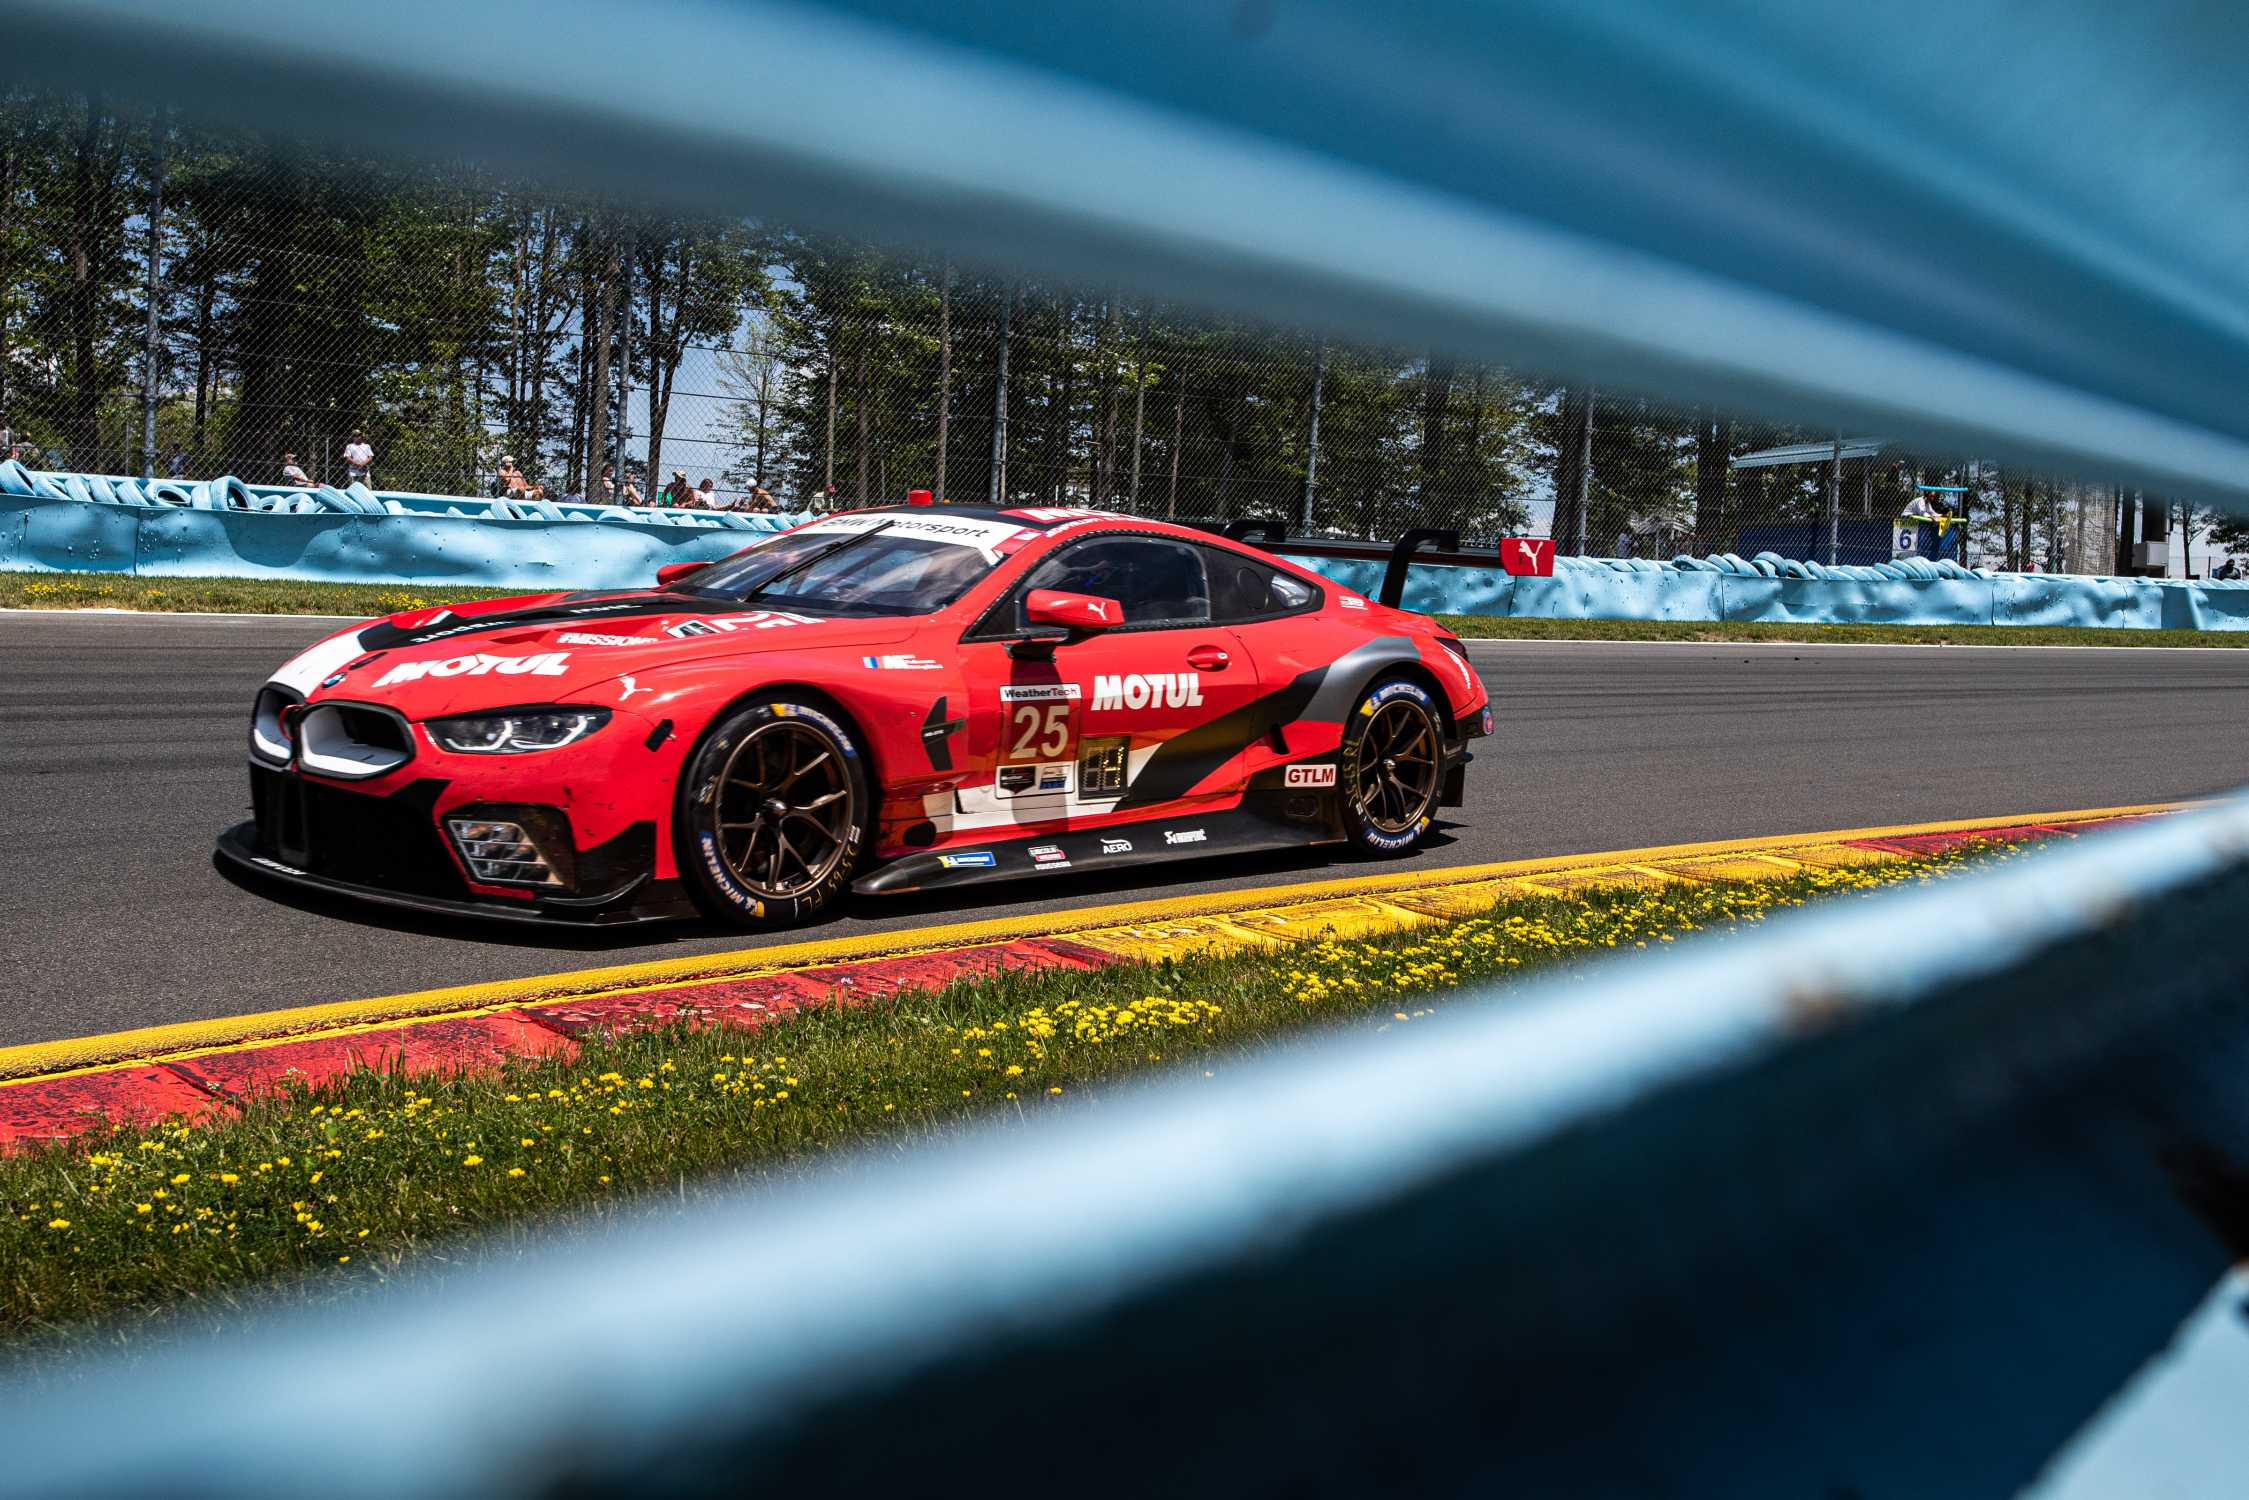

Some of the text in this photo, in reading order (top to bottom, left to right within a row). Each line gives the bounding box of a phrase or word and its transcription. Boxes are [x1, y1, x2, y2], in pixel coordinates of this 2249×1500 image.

[1899, 528, 1912, 549] 6
[371, 652, 573, 688] MOTUL
[1004, 687, 1078, 698] WeatherTech
[1091, 673, 1205, 711] MOTUL
[1009, 705, 1070, 759] 25
[1288, 768, 1334, 783] GTLM
[1103, 843, 1133, 854] AERO
[1367, 832, 1415, 848] MICHELIN
[701, 837, 745, 904] MICHELIN
